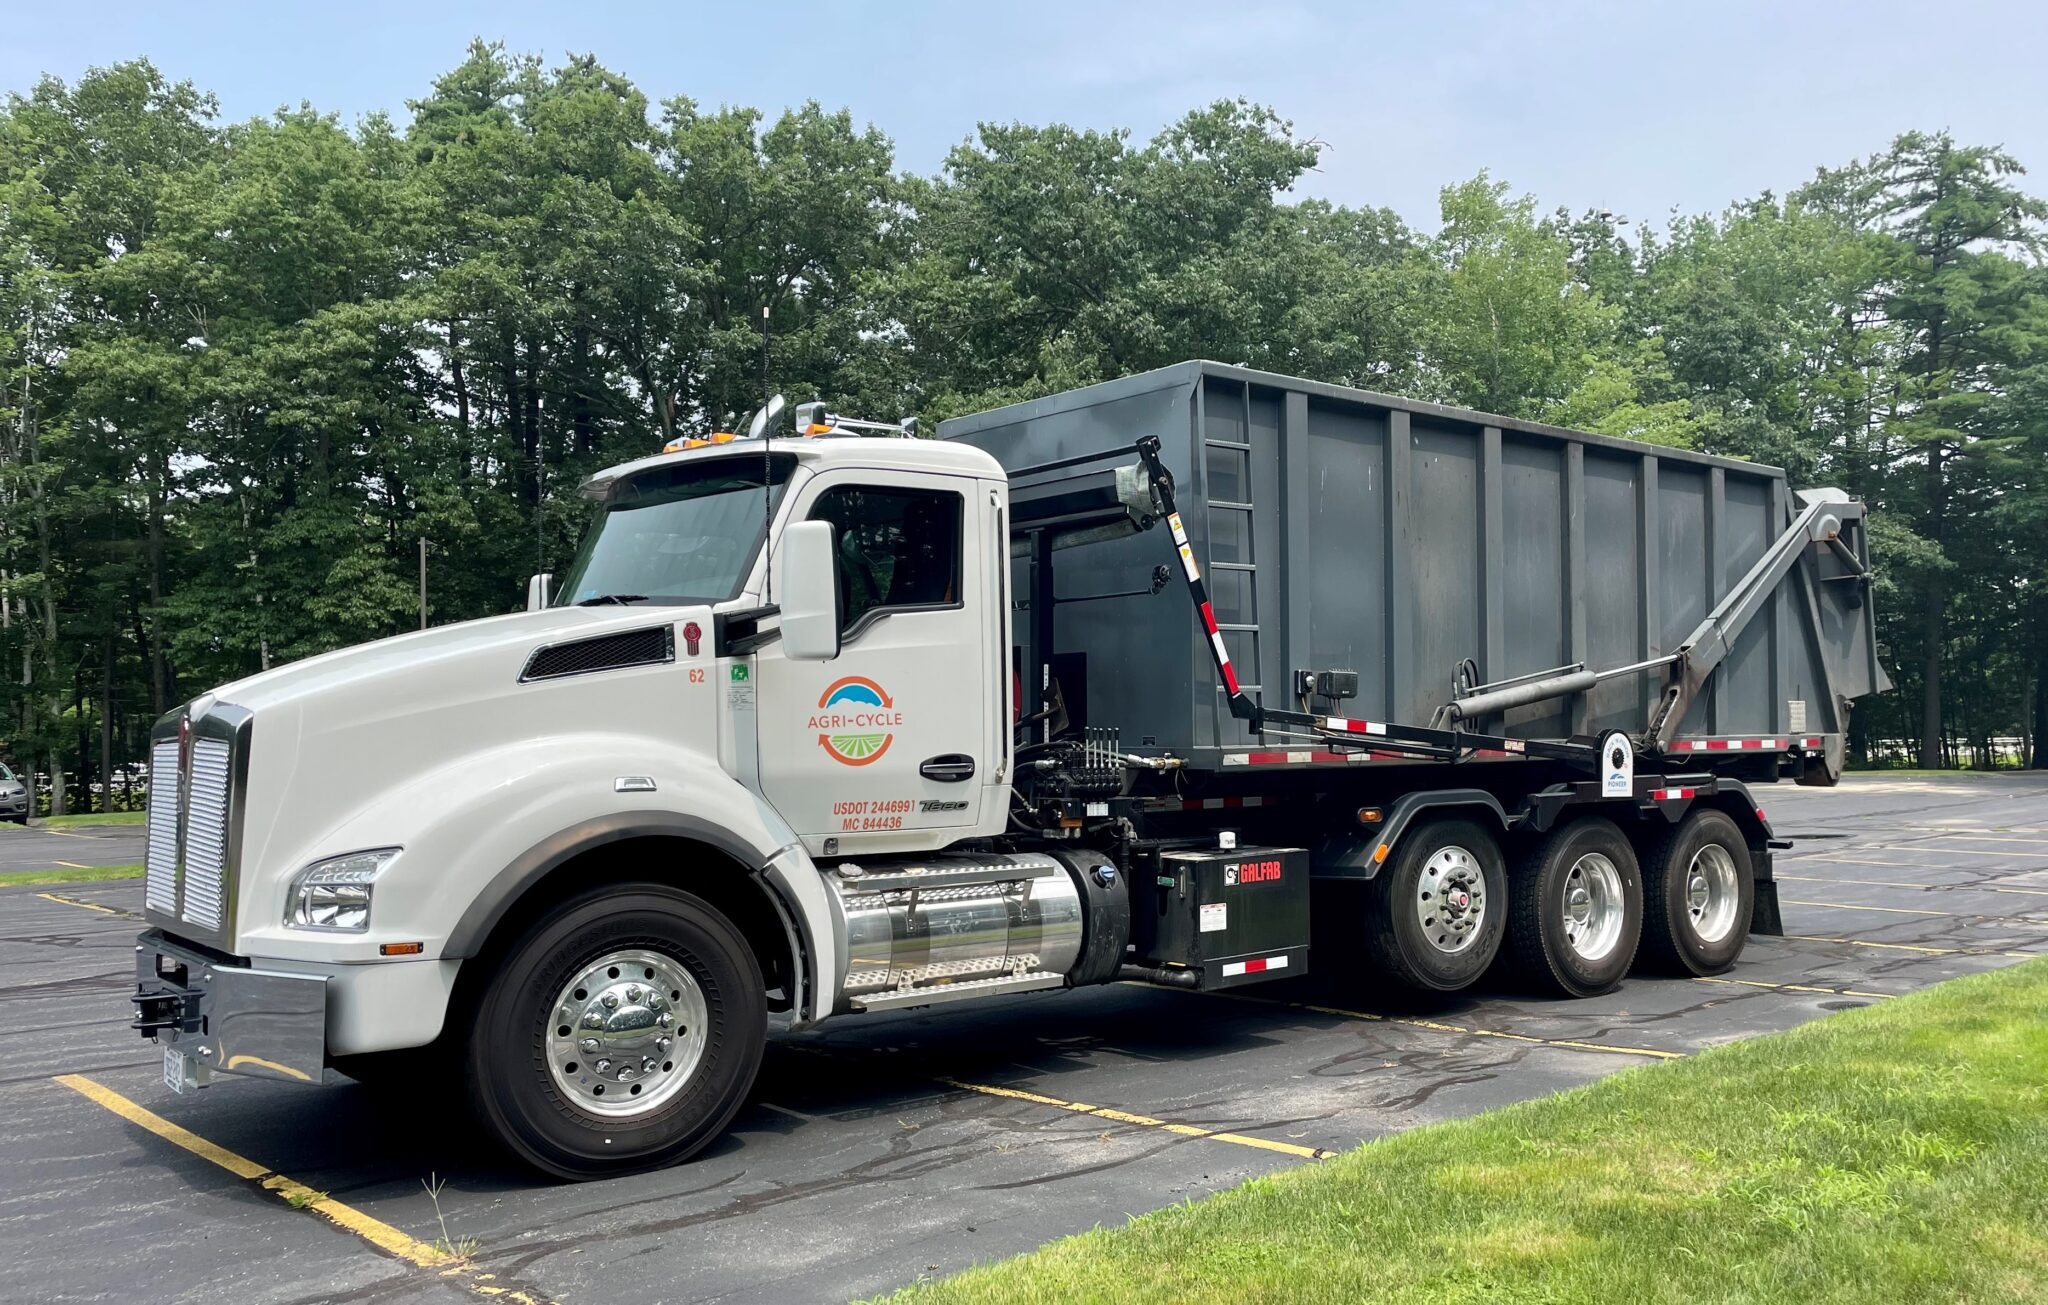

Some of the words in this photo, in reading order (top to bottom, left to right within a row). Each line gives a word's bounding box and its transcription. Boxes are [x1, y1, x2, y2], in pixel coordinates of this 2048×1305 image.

[689, 668, 704, 683] 62
[807, 713, 903, 729] AGRI-CYCLE
[833, 801, 869, 815] USDOT
[870, 799, 915, 814] 2446991
[919, 799, 969, 812] T880
[842, 817, 859, 831] MC
[861, 816, 903, 830] 844436
[1240, 860, 1281, 883] GALFAB
